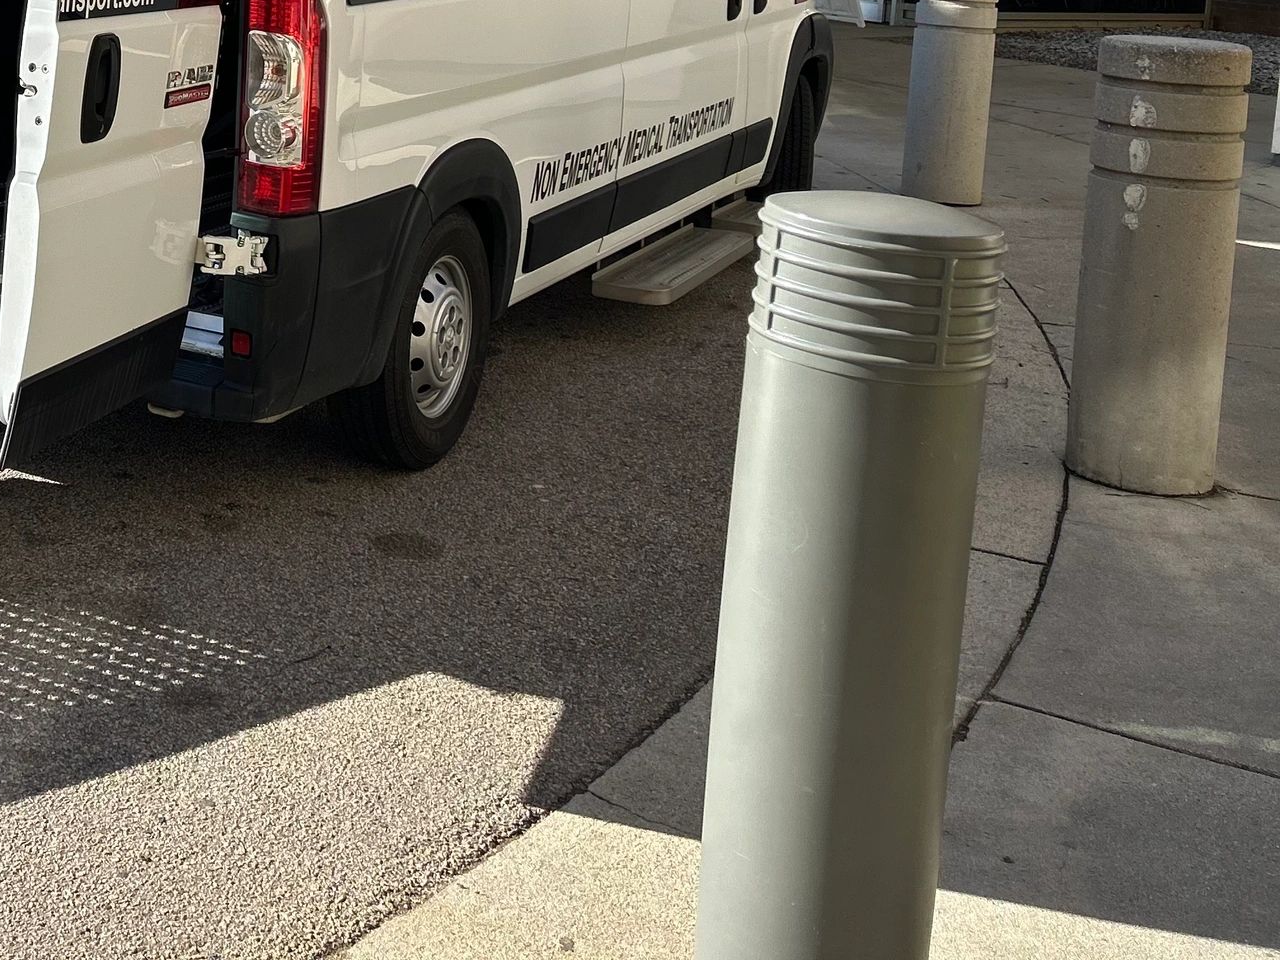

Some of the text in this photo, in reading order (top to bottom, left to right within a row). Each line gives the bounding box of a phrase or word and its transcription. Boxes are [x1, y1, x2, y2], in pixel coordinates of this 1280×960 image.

[530, 159, 561, 204] NON
[558, 135, 627, 192] EMERGENCY
[622, 122, 666, 167] MEDICAL
